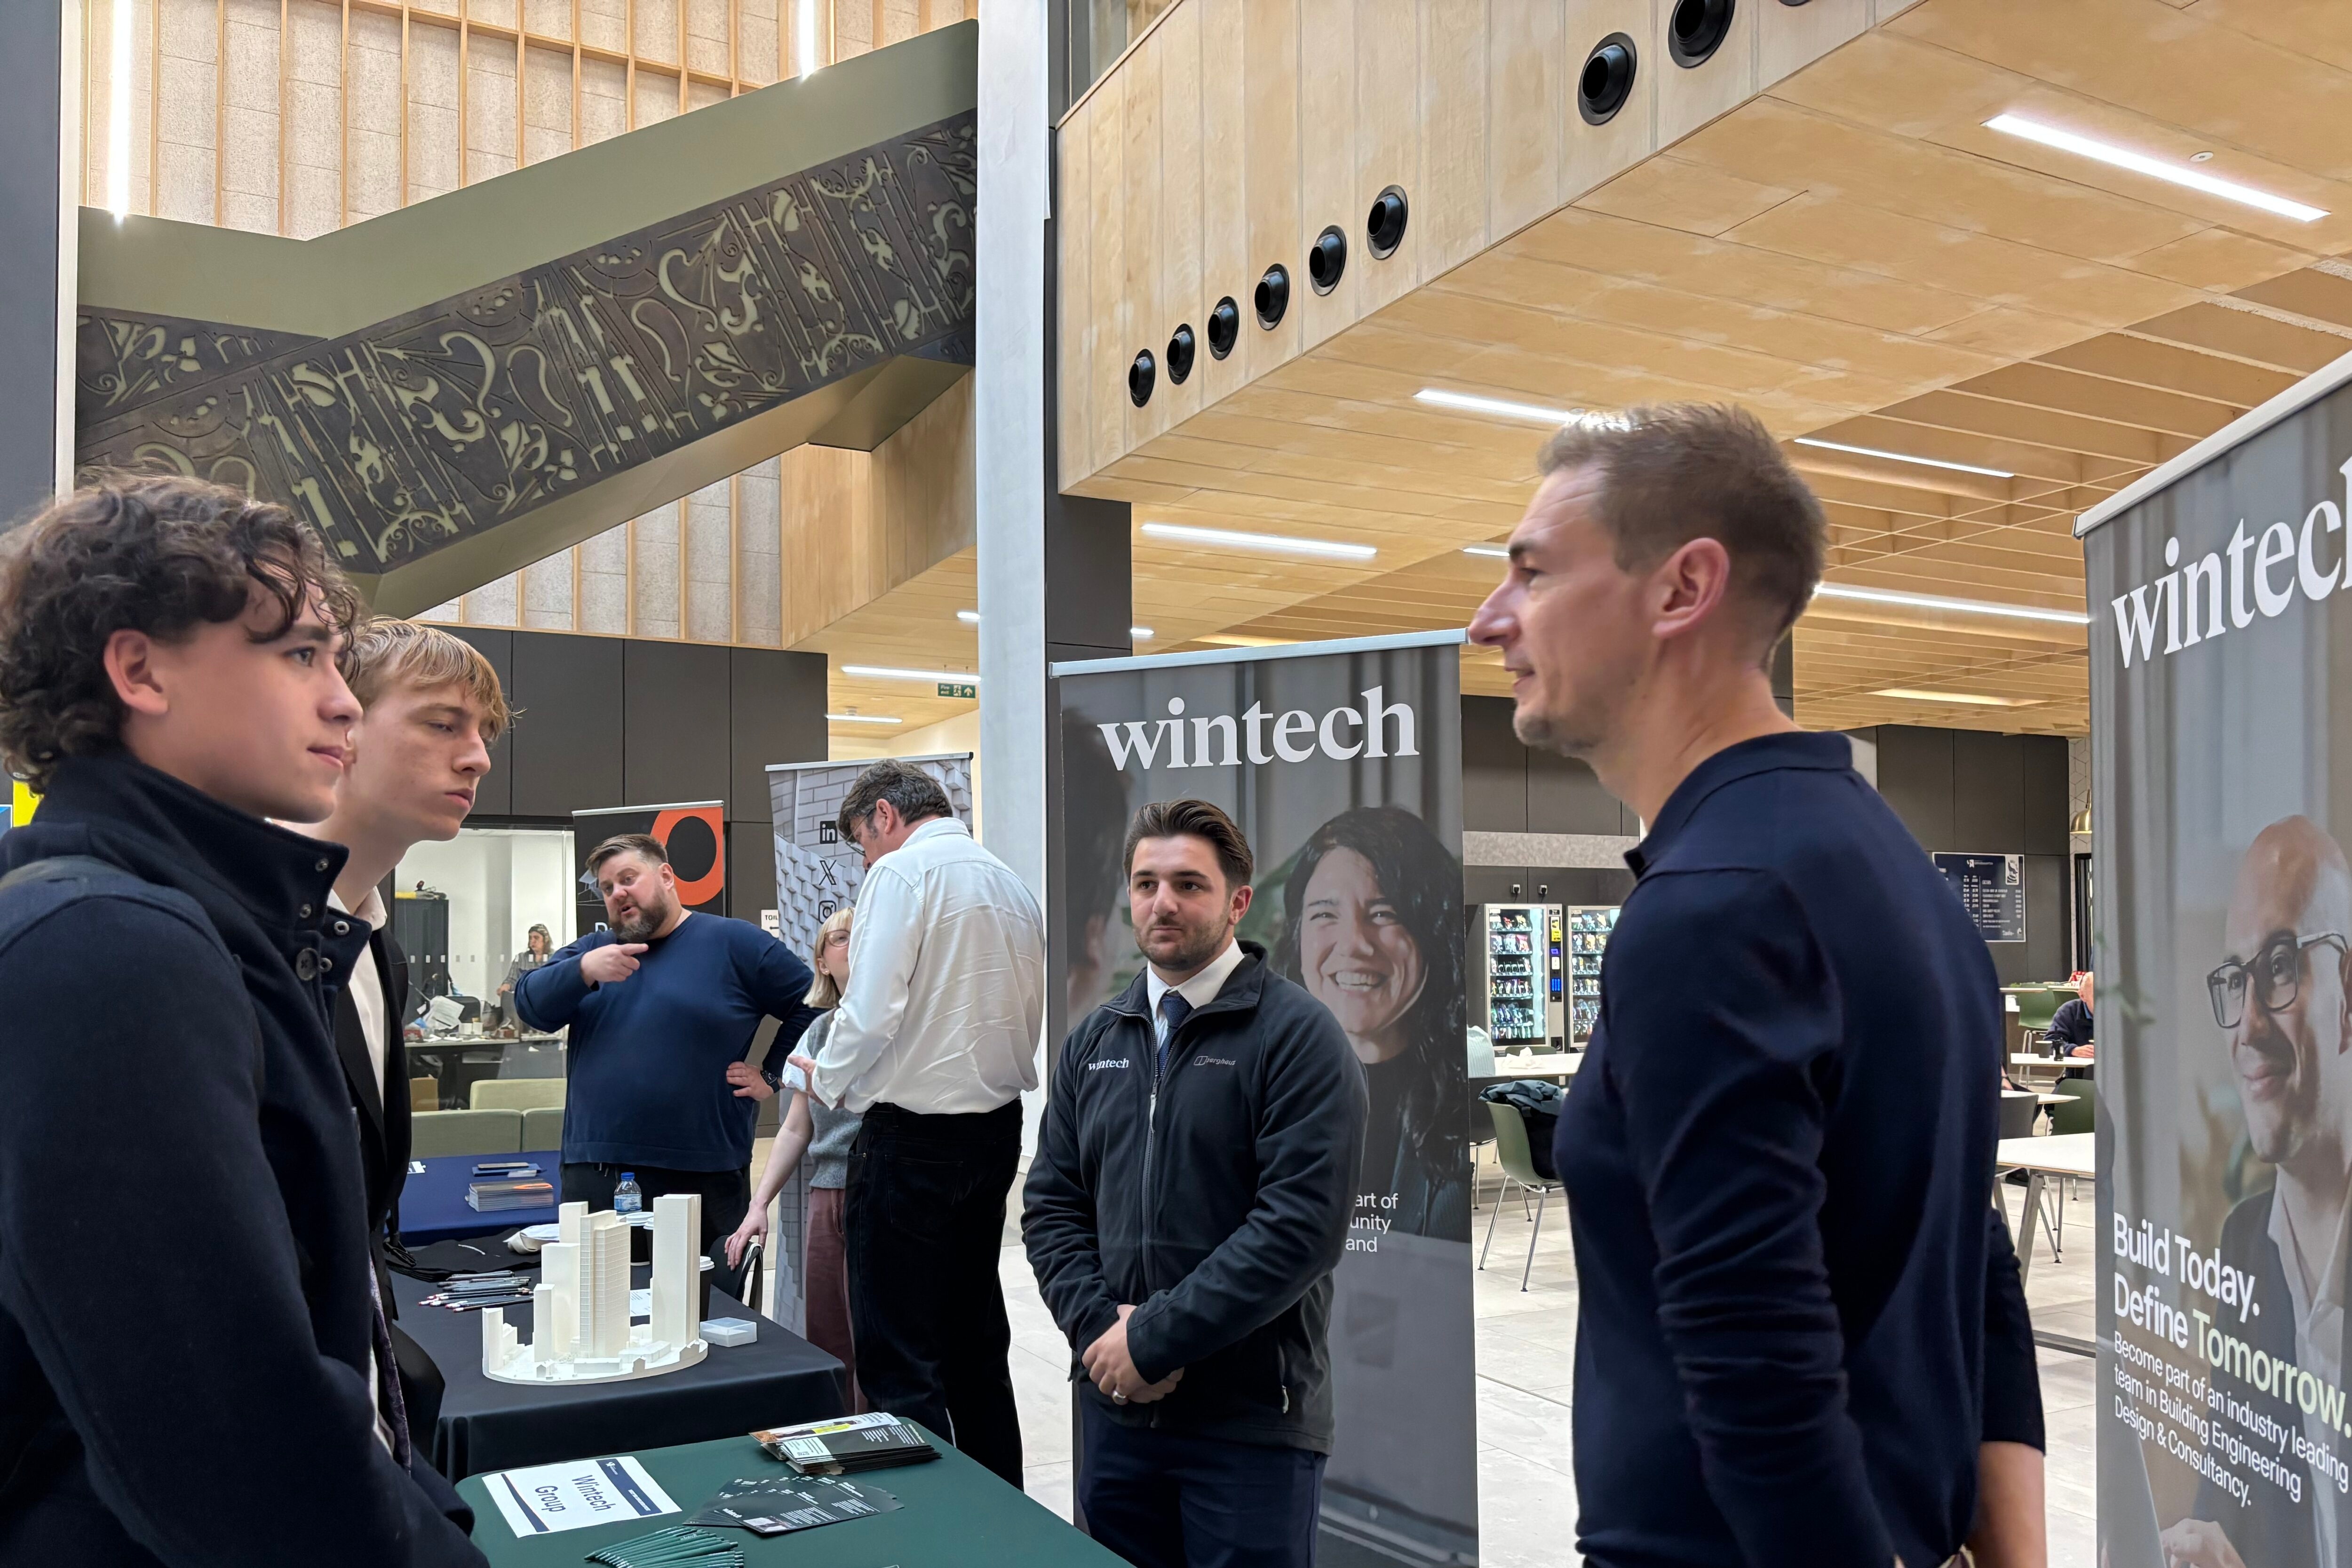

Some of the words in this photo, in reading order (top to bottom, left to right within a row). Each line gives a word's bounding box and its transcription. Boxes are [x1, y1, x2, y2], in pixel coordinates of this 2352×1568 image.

[2112, 455, 2352, 669] wintec
[1097, 685, 1419, 771] wintech
[1089, 1058, 1129, 1071] wintech
[1346, 1236, 1377, 1252] and
[1381, 1193, 1398, 1209] of
[2114, 1212, 2169, 1275] Build
[2176, 1235, 2260, 1322] Today.
[2115, 1273, 2188, 1348] Define
[2193, 1309, 2352, 1438] Tomorrow.
[2115, 1331, 2162, 1375] Become
[2166, 1364, 2190, 1392] part
[2193, 1376, 2207, 1398] of
[2208, 1386, 2224, 1409] an
[2228, 1392, 2287, 1449] industry
[2292, 1429, 2348, 1493] leading
[2115, 1366, 2143, 1393] team
[2146, 1381, 2156, 1406] in
[2160, 1390, 2208, 1445] Building
[2213, 1424, 2301, 1503] Engineering
[2115, 1396, 2154, 1439] Design
[2158, 1425, 2166, 1447] &
[2169, 1430, 2251, 1505] Consultancy.
[535, 1485, 566, 1512] Group
[572, 1474, 615, 1512] Wintech
